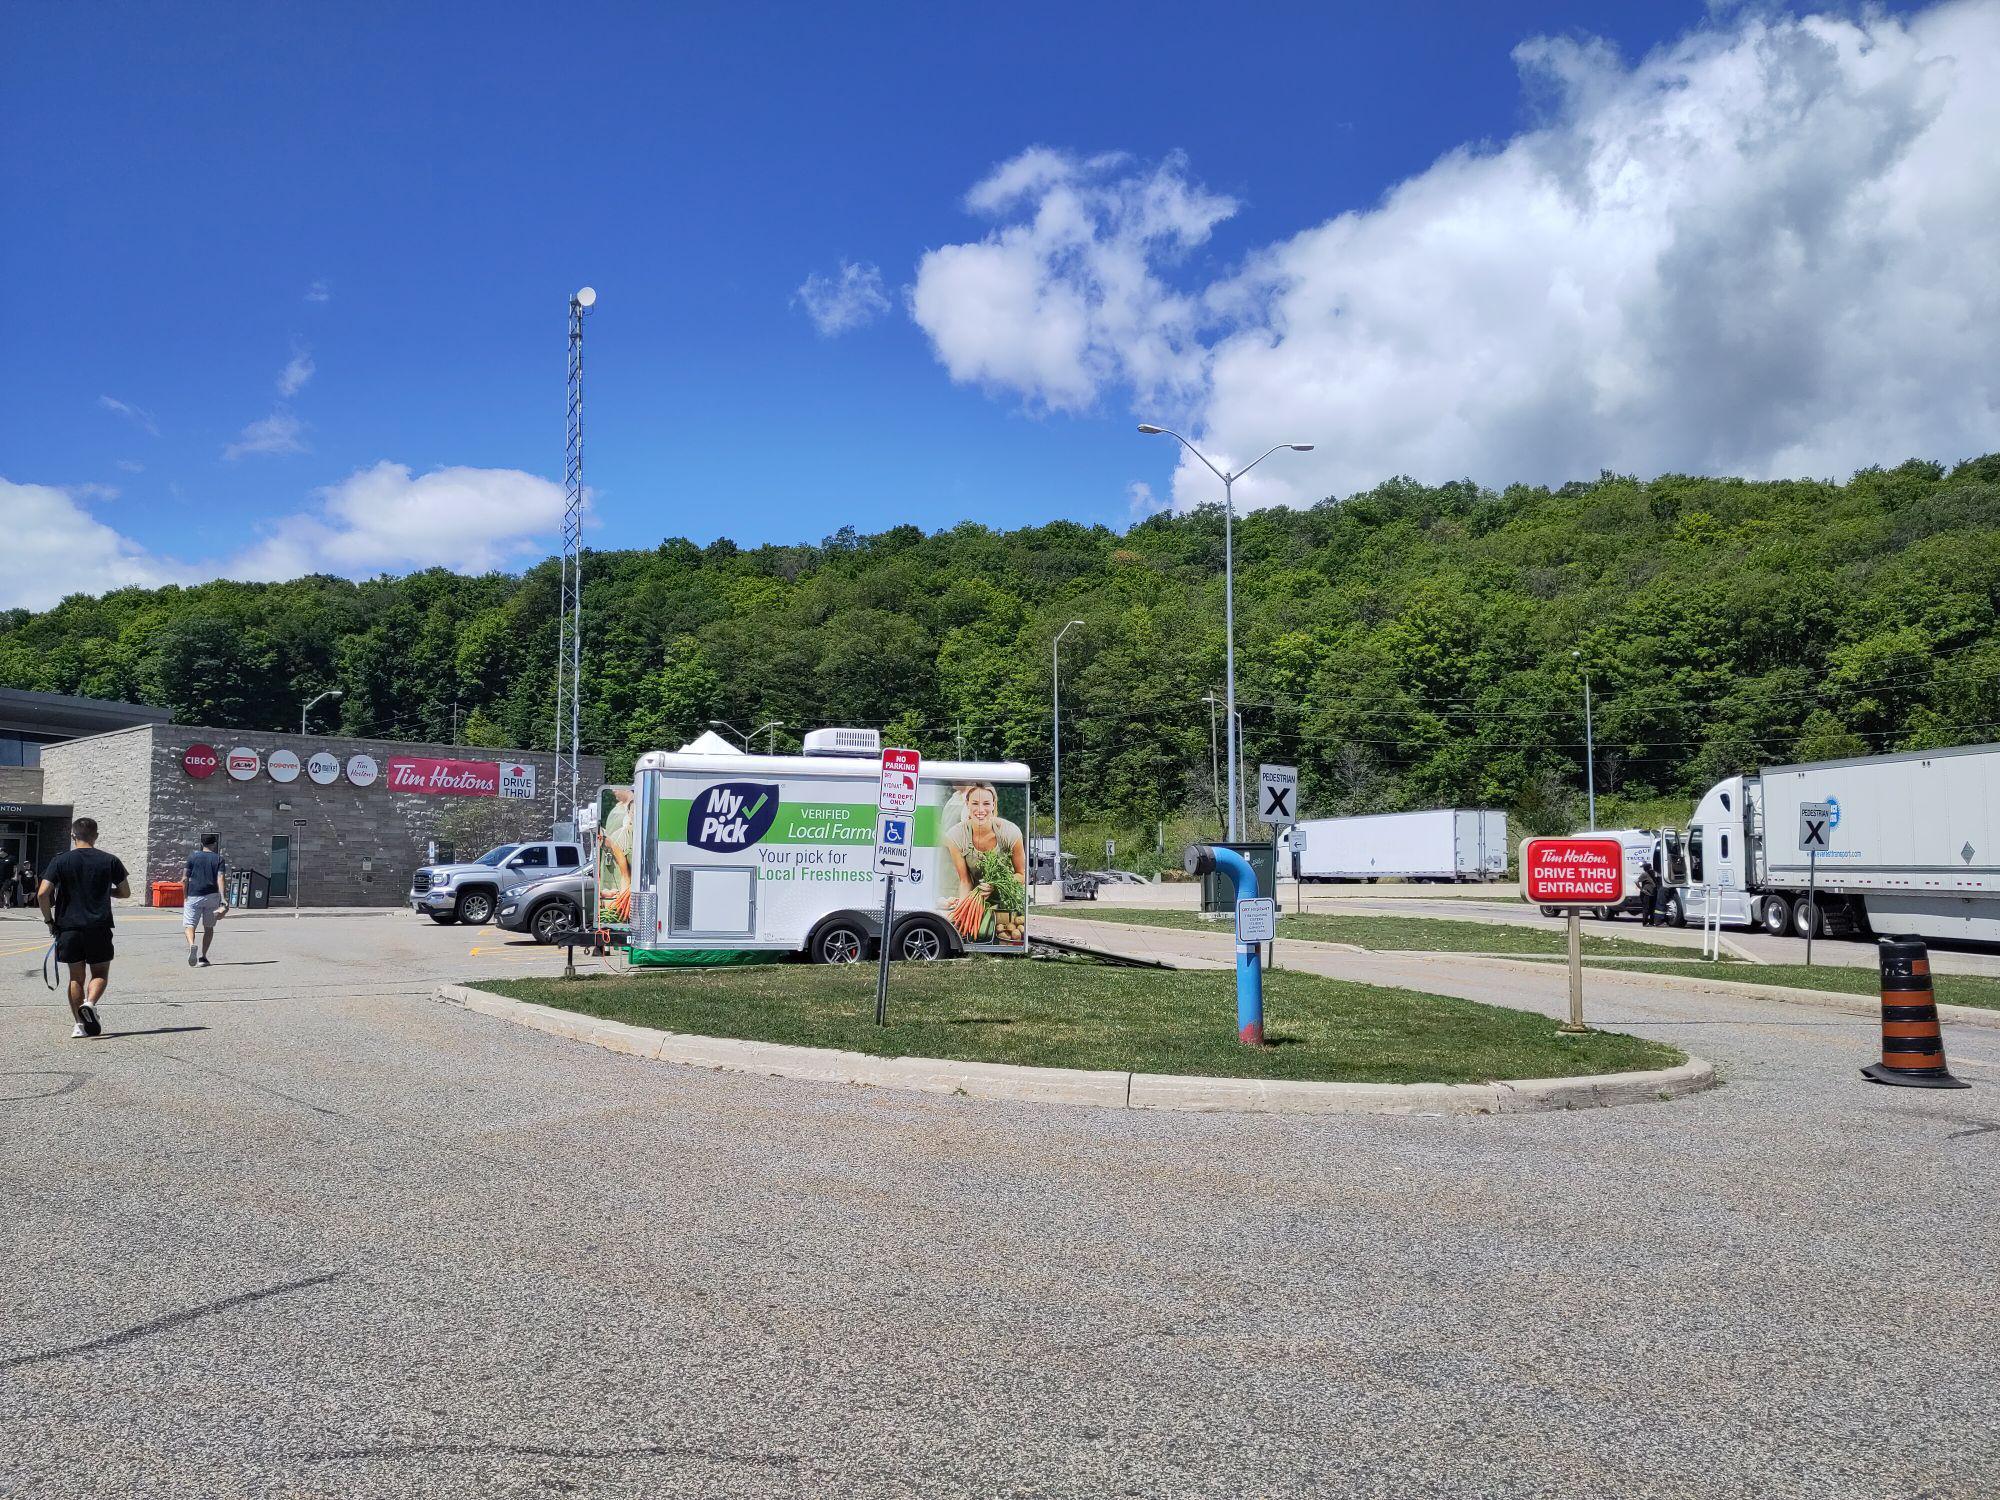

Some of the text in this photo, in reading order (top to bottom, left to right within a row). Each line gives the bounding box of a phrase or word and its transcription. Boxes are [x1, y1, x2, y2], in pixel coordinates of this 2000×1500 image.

[185, 756, 206, 765] CIBC
[231, 760, 256, 769] A&W
[895, 755, 907, 763] NO
[885, 762, 916, 771] PARKING
[393, 764, 495, 791] Tim Hortons
[503, 777, 532, 788] DRIVE
[1262, 772, 1296, 784] PEDESTRIAN
[504, 788, 531, 799] THRU
[706, 789, 744, 820] My
[1264, 786, 1291, 817] X
[800, 808, 850, 820] VERIFIED
[1801, 809, 1829, 818] PEDESTRIAN
[700, 816, 751, 843] Pick
[788, 823, 829, 840] Local
[1803, 820, 1825, 845] X
[878, 845, 907, 857] PARKING
[1541, 848, 1607, 864] Tim Hortons
[758, 848, 848, 867] Your pick for
[757, 866, 873, 882] Local Freshness
[1534, 867, 1617, 879] DRIVE THRU
[1538, 881, 1614, 894] ENTRANCE
